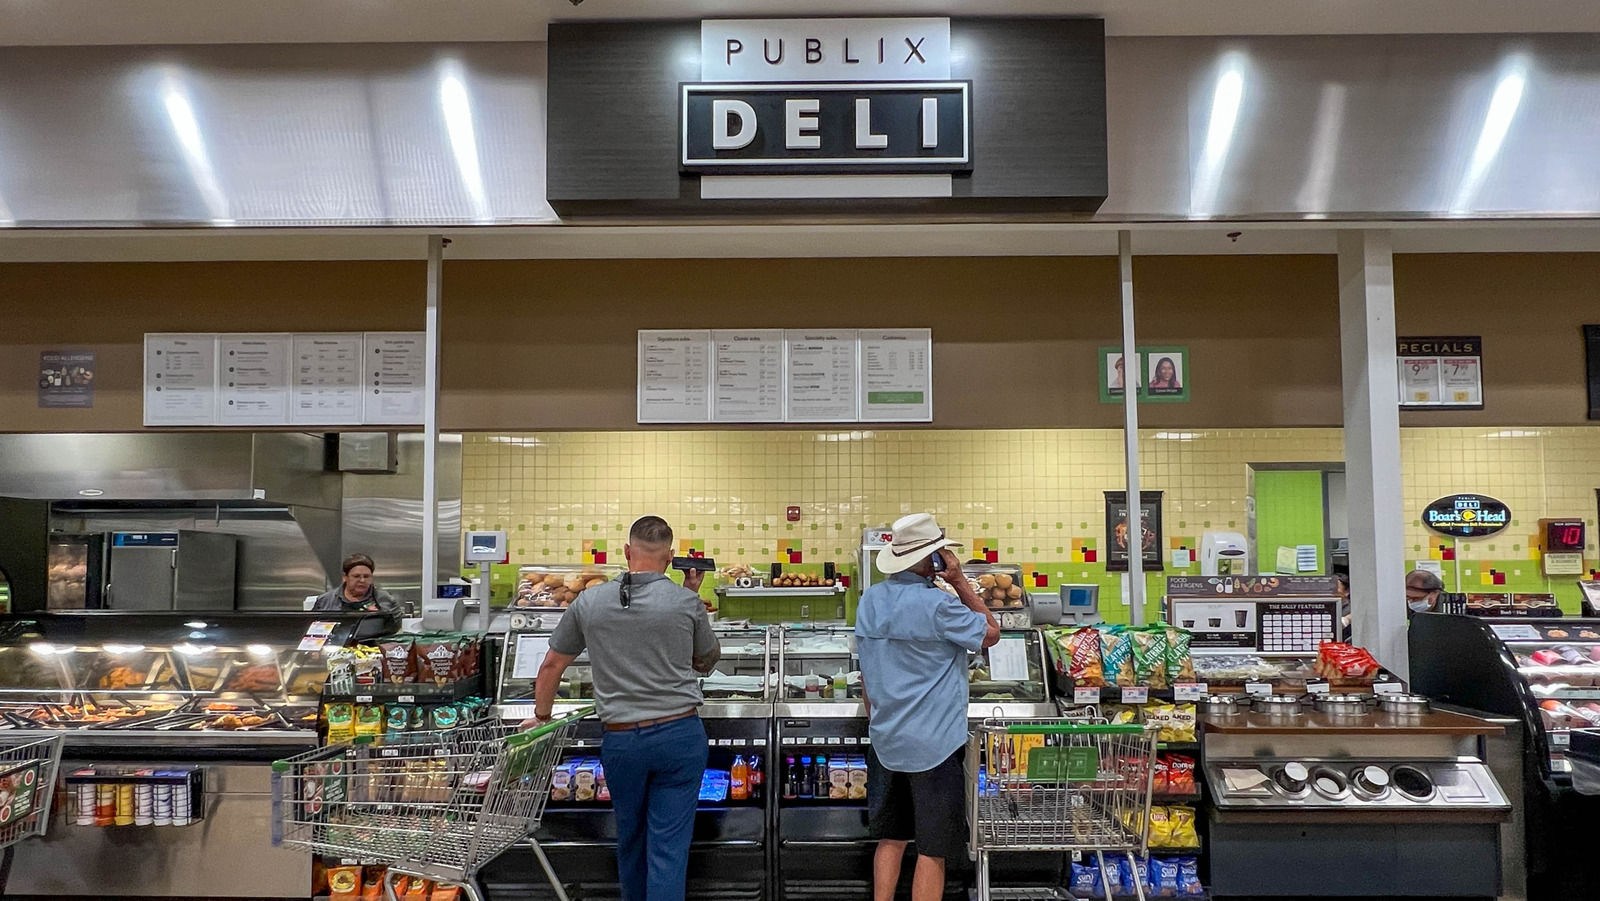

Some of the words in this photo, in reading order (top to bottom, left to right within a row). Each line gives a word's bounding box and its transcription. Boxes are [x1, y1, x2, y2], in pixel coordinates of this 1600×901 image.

[726, 37, 926, 64] PUBLIX
[713, 98, 938, 149] DELI
[1399, 343, 1474, 353] PECIALS
[1429, 510, 1461, 521] Boar's
[1476, 510, 1506, 521] Head
